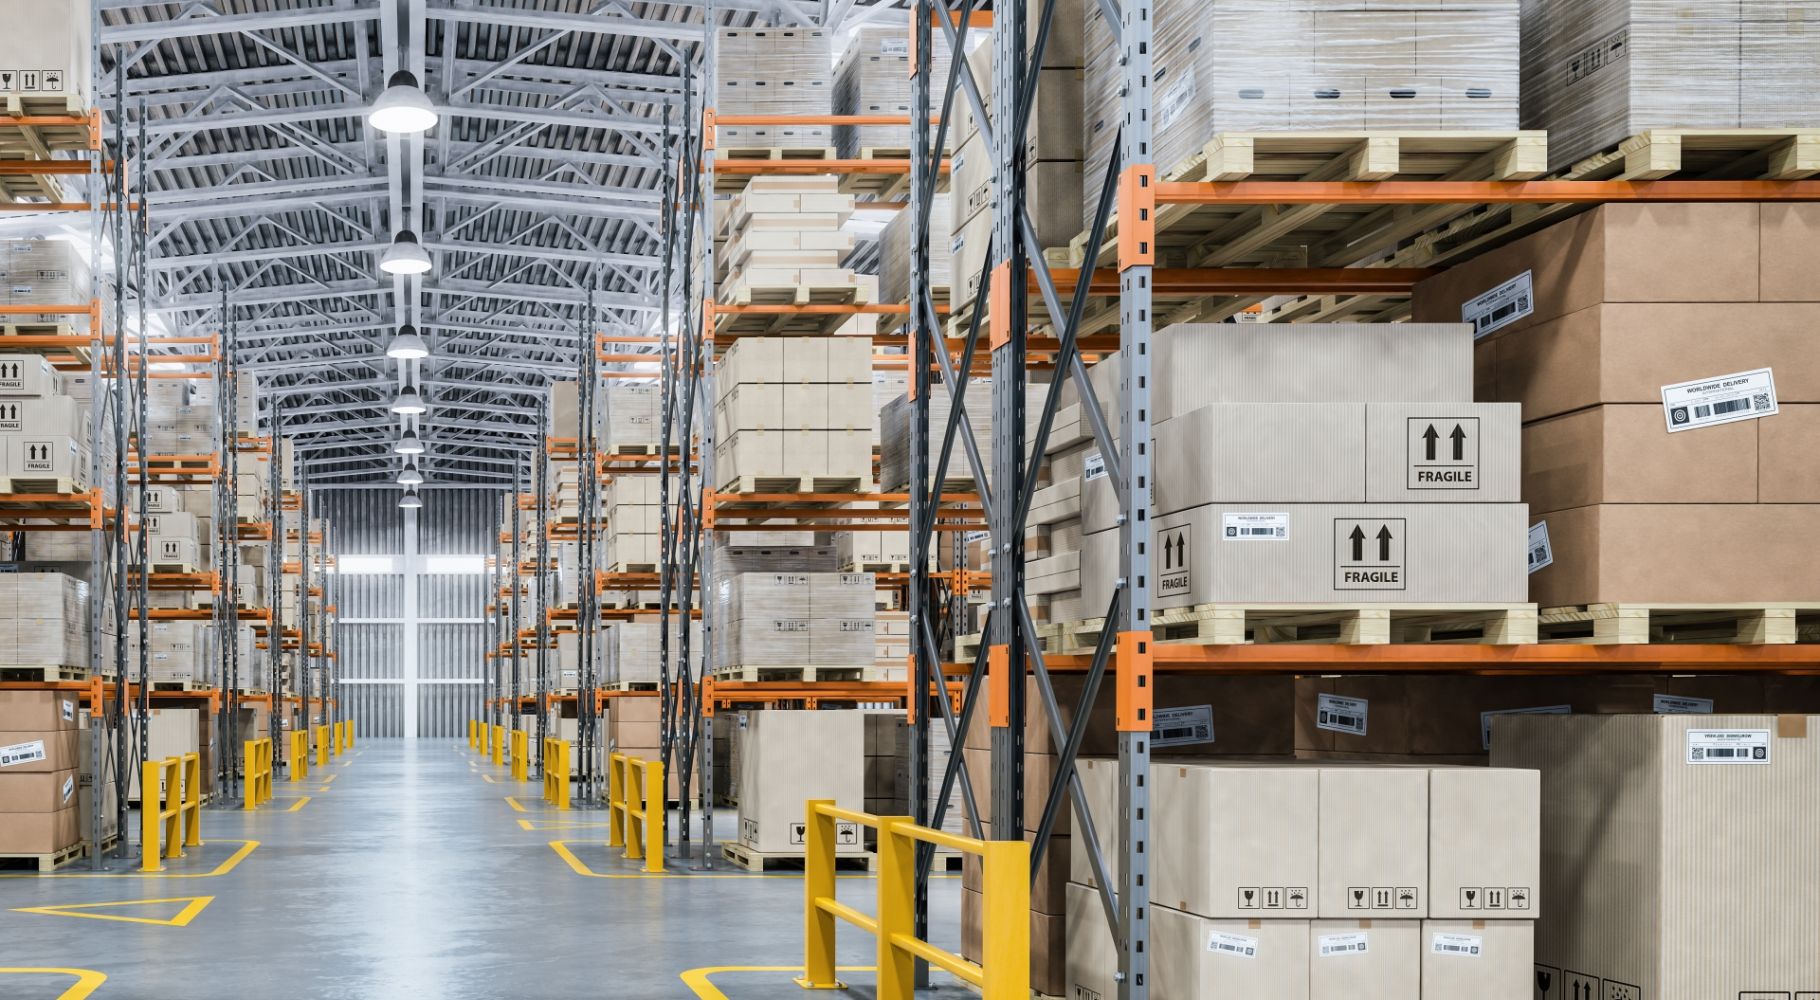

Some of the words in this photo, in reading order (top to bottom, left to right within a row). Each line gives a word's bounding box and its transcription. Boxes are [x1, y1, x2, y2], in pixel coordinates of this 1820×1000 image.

[1687, 383, 1720, 394] WORLDWIDE
[1722, 378, 1749, 386] DELIVERY
[1418, 470, 1472, 482] FRAGILE
[1162, 576, 1188, 590] FRAGILE
[1344, 572, 1398, 582] FRAGILE
